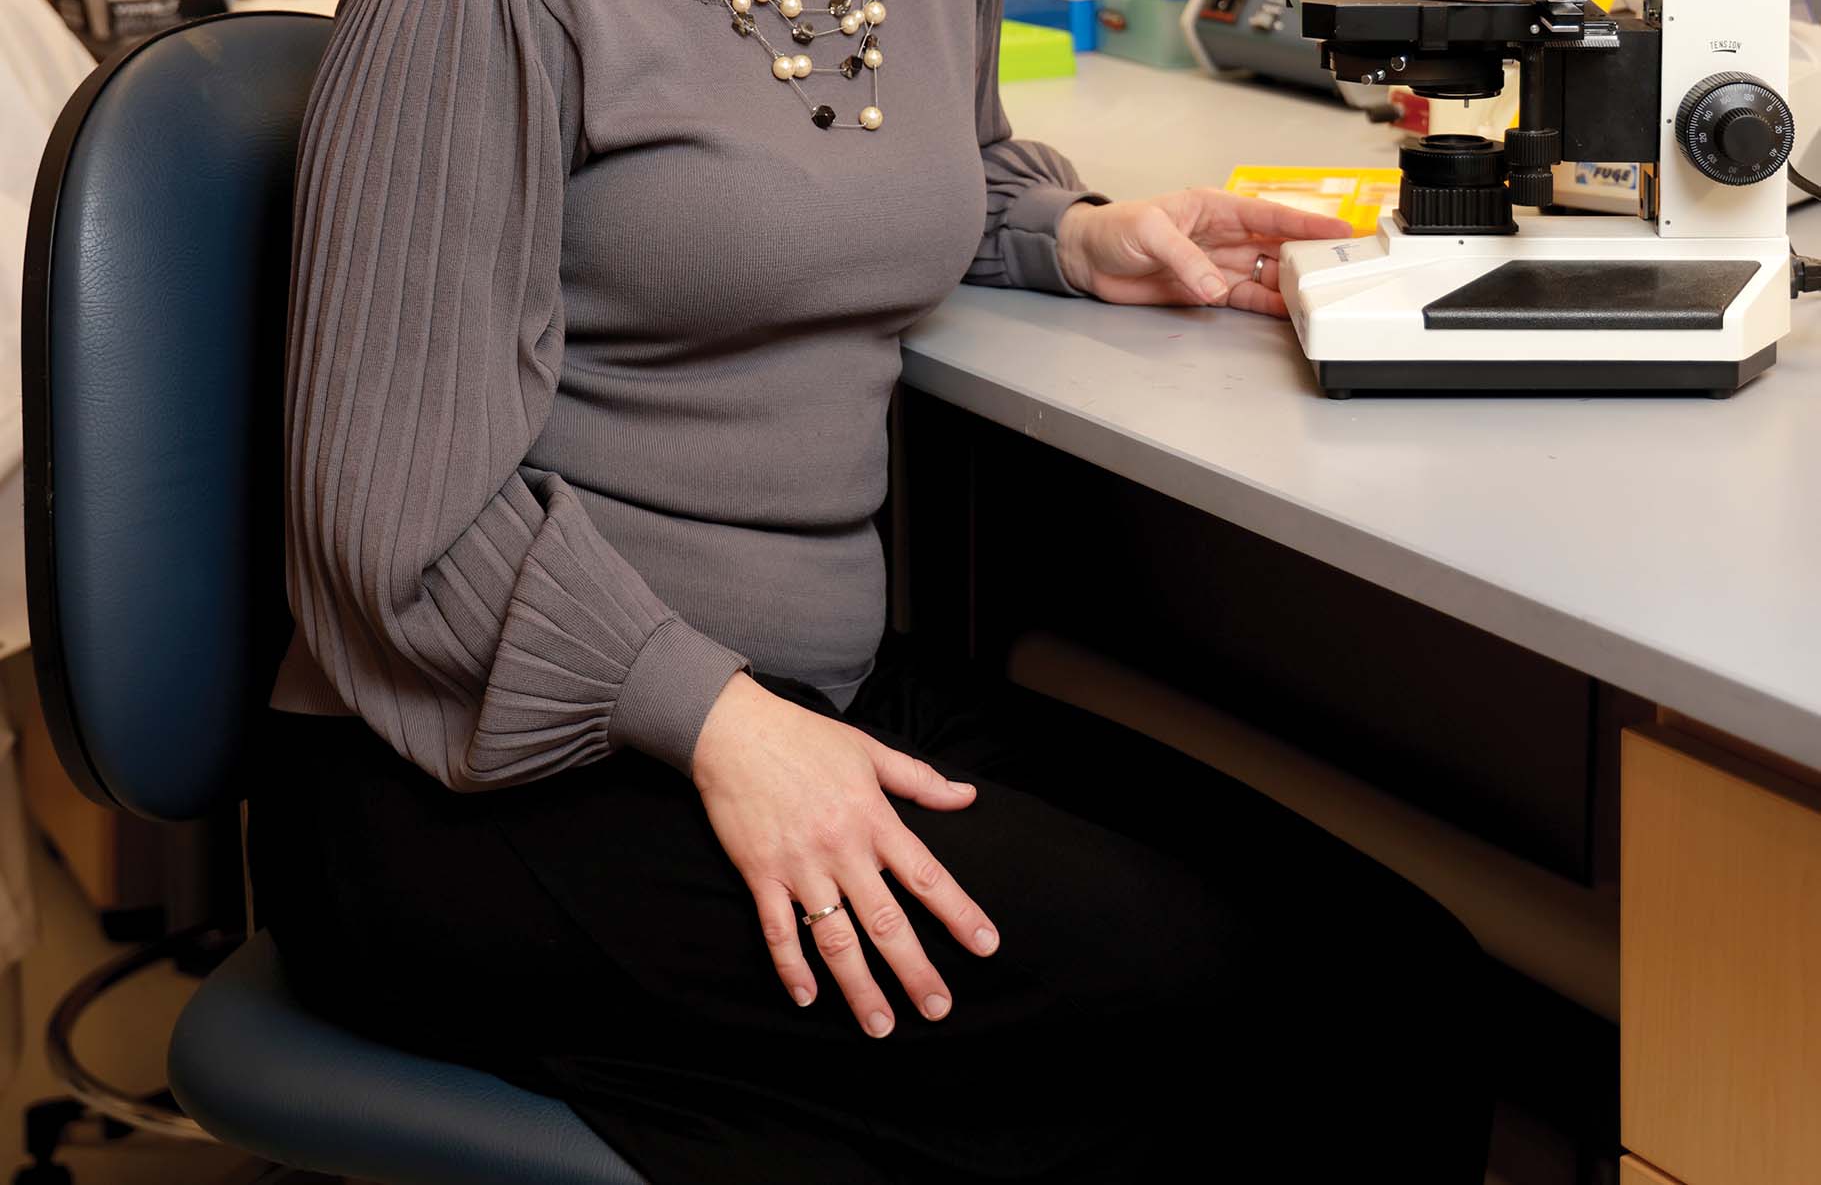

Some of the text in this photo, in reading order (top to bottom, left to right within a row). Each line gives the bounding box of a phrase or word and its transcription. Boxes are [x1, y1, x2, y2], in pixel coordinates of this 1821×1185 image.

[1709, 39, 1742, 51] TENSION
[1703, 110, 1713, 121] 140
[1775, 125, 1783, 134] 20
[1768, 147, 1779, 158] 40
